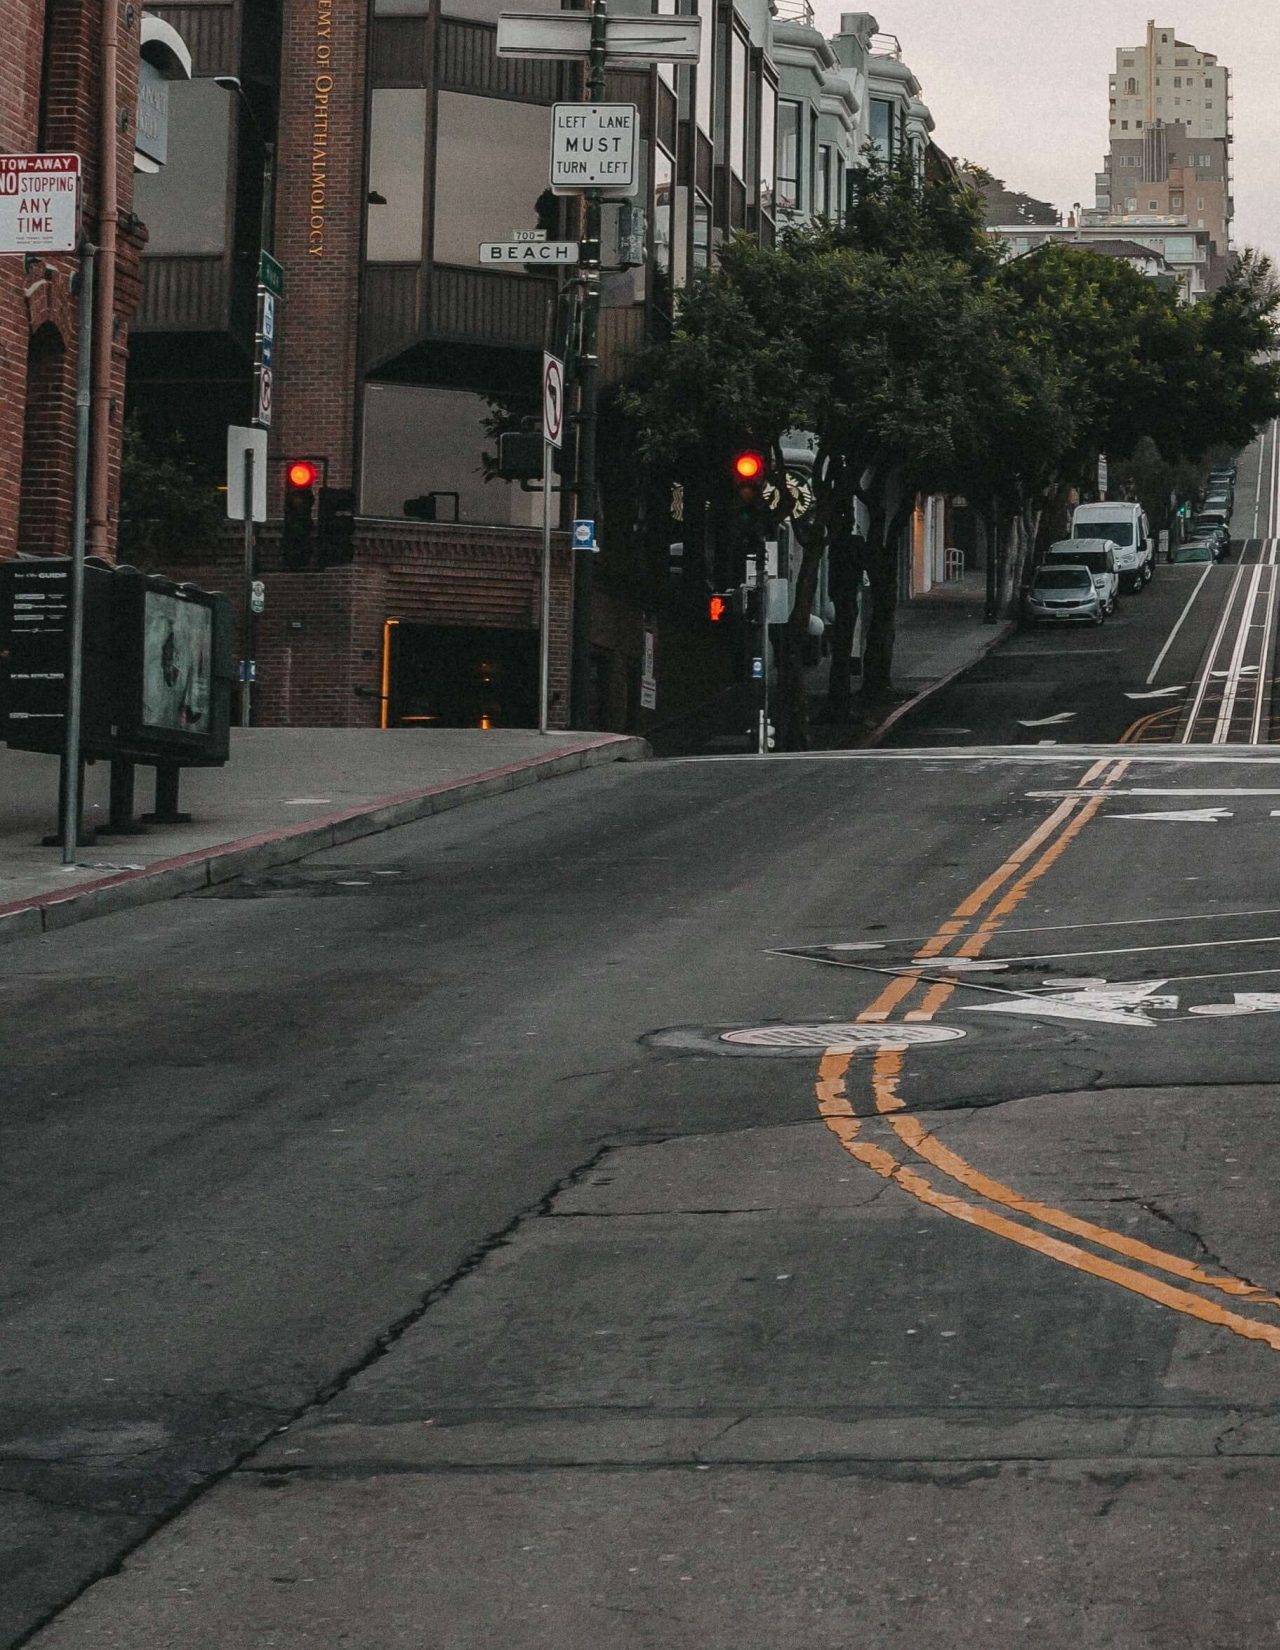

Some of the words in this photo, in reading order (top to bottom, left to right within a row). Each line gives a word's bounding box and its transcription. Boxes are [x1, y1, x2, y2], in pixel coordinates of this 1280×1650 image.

[316, 45, 330, 68] OF
[558, 116, 587, 128] LEFT
[599, 116, 631, 128] LANE
[566, 137, 621, 152] MUST
[1, 158, 71, 170] TOW-AWAY
[309, 75, 333, 258] OPHTHALMOLOGY
[557, 161, 587, 173] TURN
[600, 161, 628, 173] LEFT
[21, 176, 74, 192] STOPPING
[19, 198, 51, 213] ANY
[17, 217, 53, 232] TIME
[491, 247, 568, 259] BEACH
